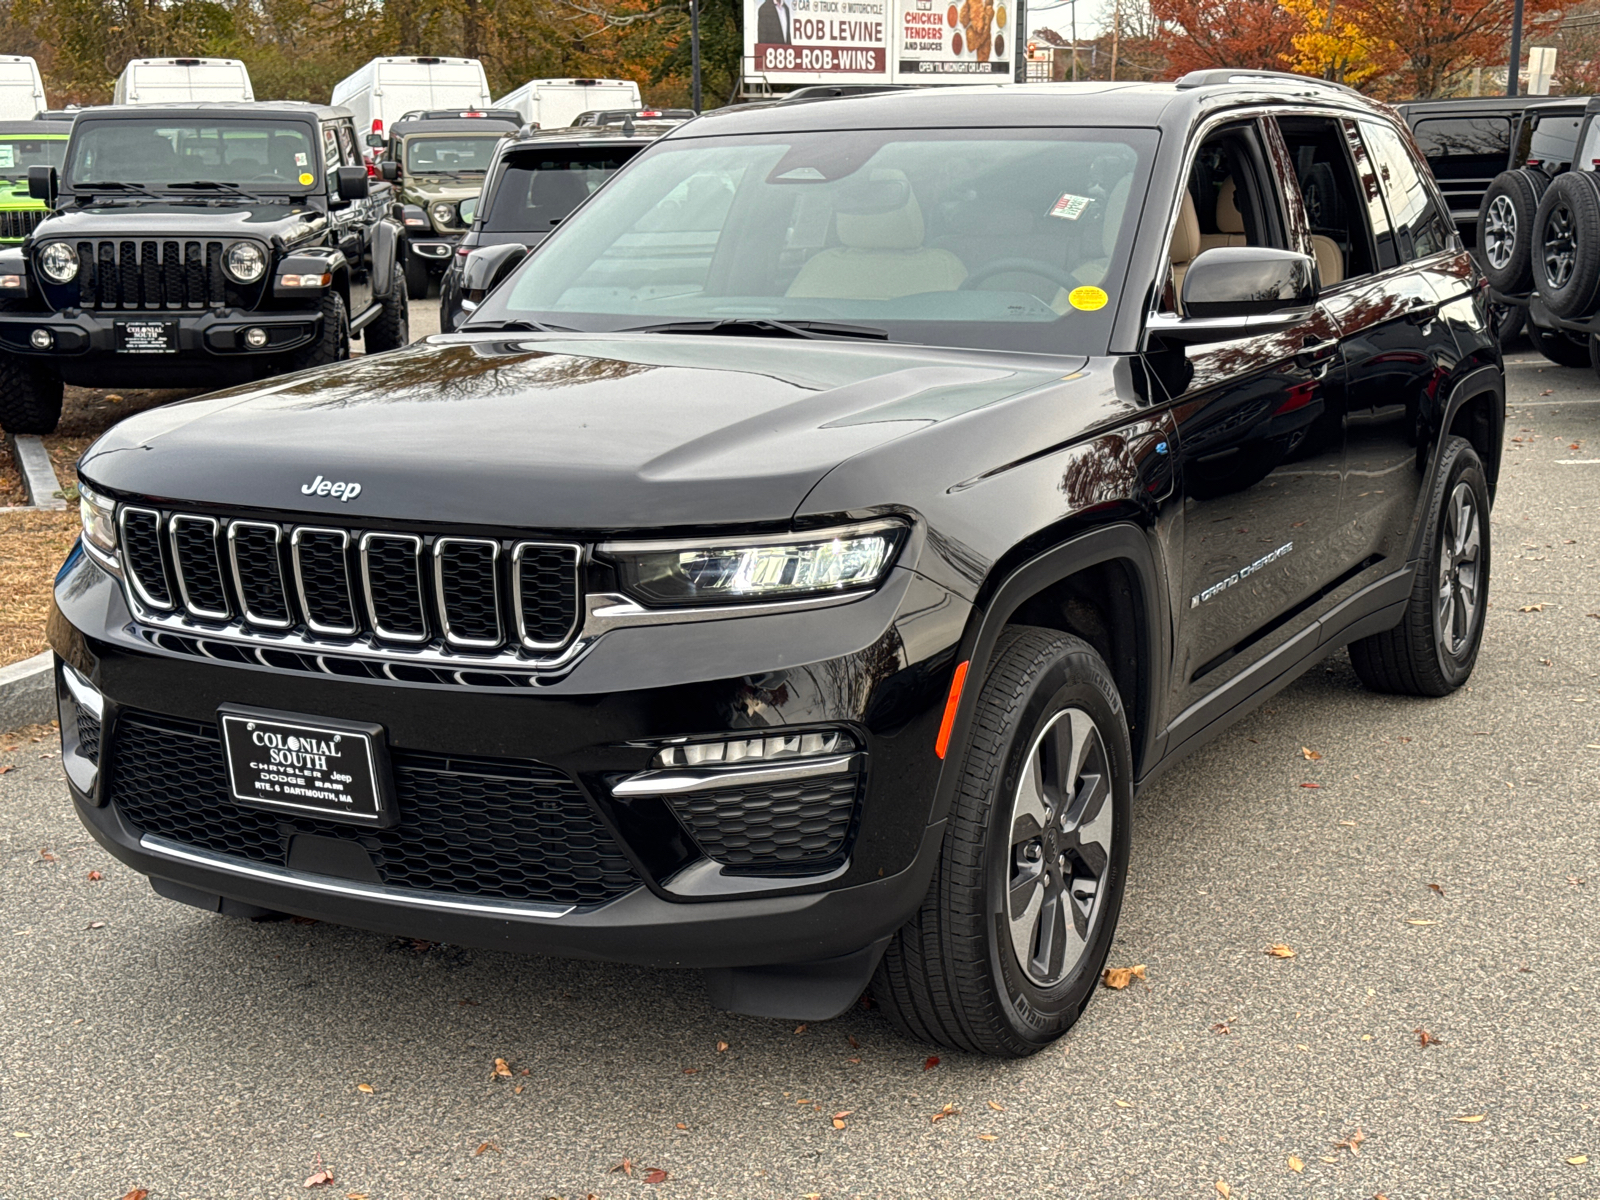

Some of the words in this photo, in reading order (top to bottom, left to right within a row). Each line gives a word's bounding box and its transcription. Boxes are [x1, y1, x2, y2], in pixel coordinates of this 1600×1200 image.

[798, 0, 810, 11] CAR
[820, 1, 840, 12] TRUCK
[848, 3, 883, 15] MOTORCYCLE
[904, 11, 943, 25] CHICKEN
[793, 18, 826, 40] ROB
[829, 20, 883, 42] LEVINE
[904, 26, 943, 40] TENDERS
[904, 41, 918, 50] AND
[919, 41, 942, 51] SAUCES
[765, 47, 876, 70] 888-ROB-WINS
[918, 62, 934, 73] OPEN
[976, 62, 992, 73] LATER
[301, 475, 362, 502] Jeep
[1201, 573, 1239, 601] GRAND
[1240, 541, 1293, 579] CHEROKEE
[252, 731, 341, 757] COLONIAL
[270, 749, 328, 771] SOUTH
[249, 762, 322, 778] CHRYSLER
[330, 771, 353, 784] Jeep
[260, 772, 306, 785] DODGE
[314, 781, 344, 792] RAM
[254, 781, 276, 791] RTE.
[274, 784, 281, 792] 6
[284, 787, 338, 802] DARTMOUTH,
[339, 794, 354, 803] MA
